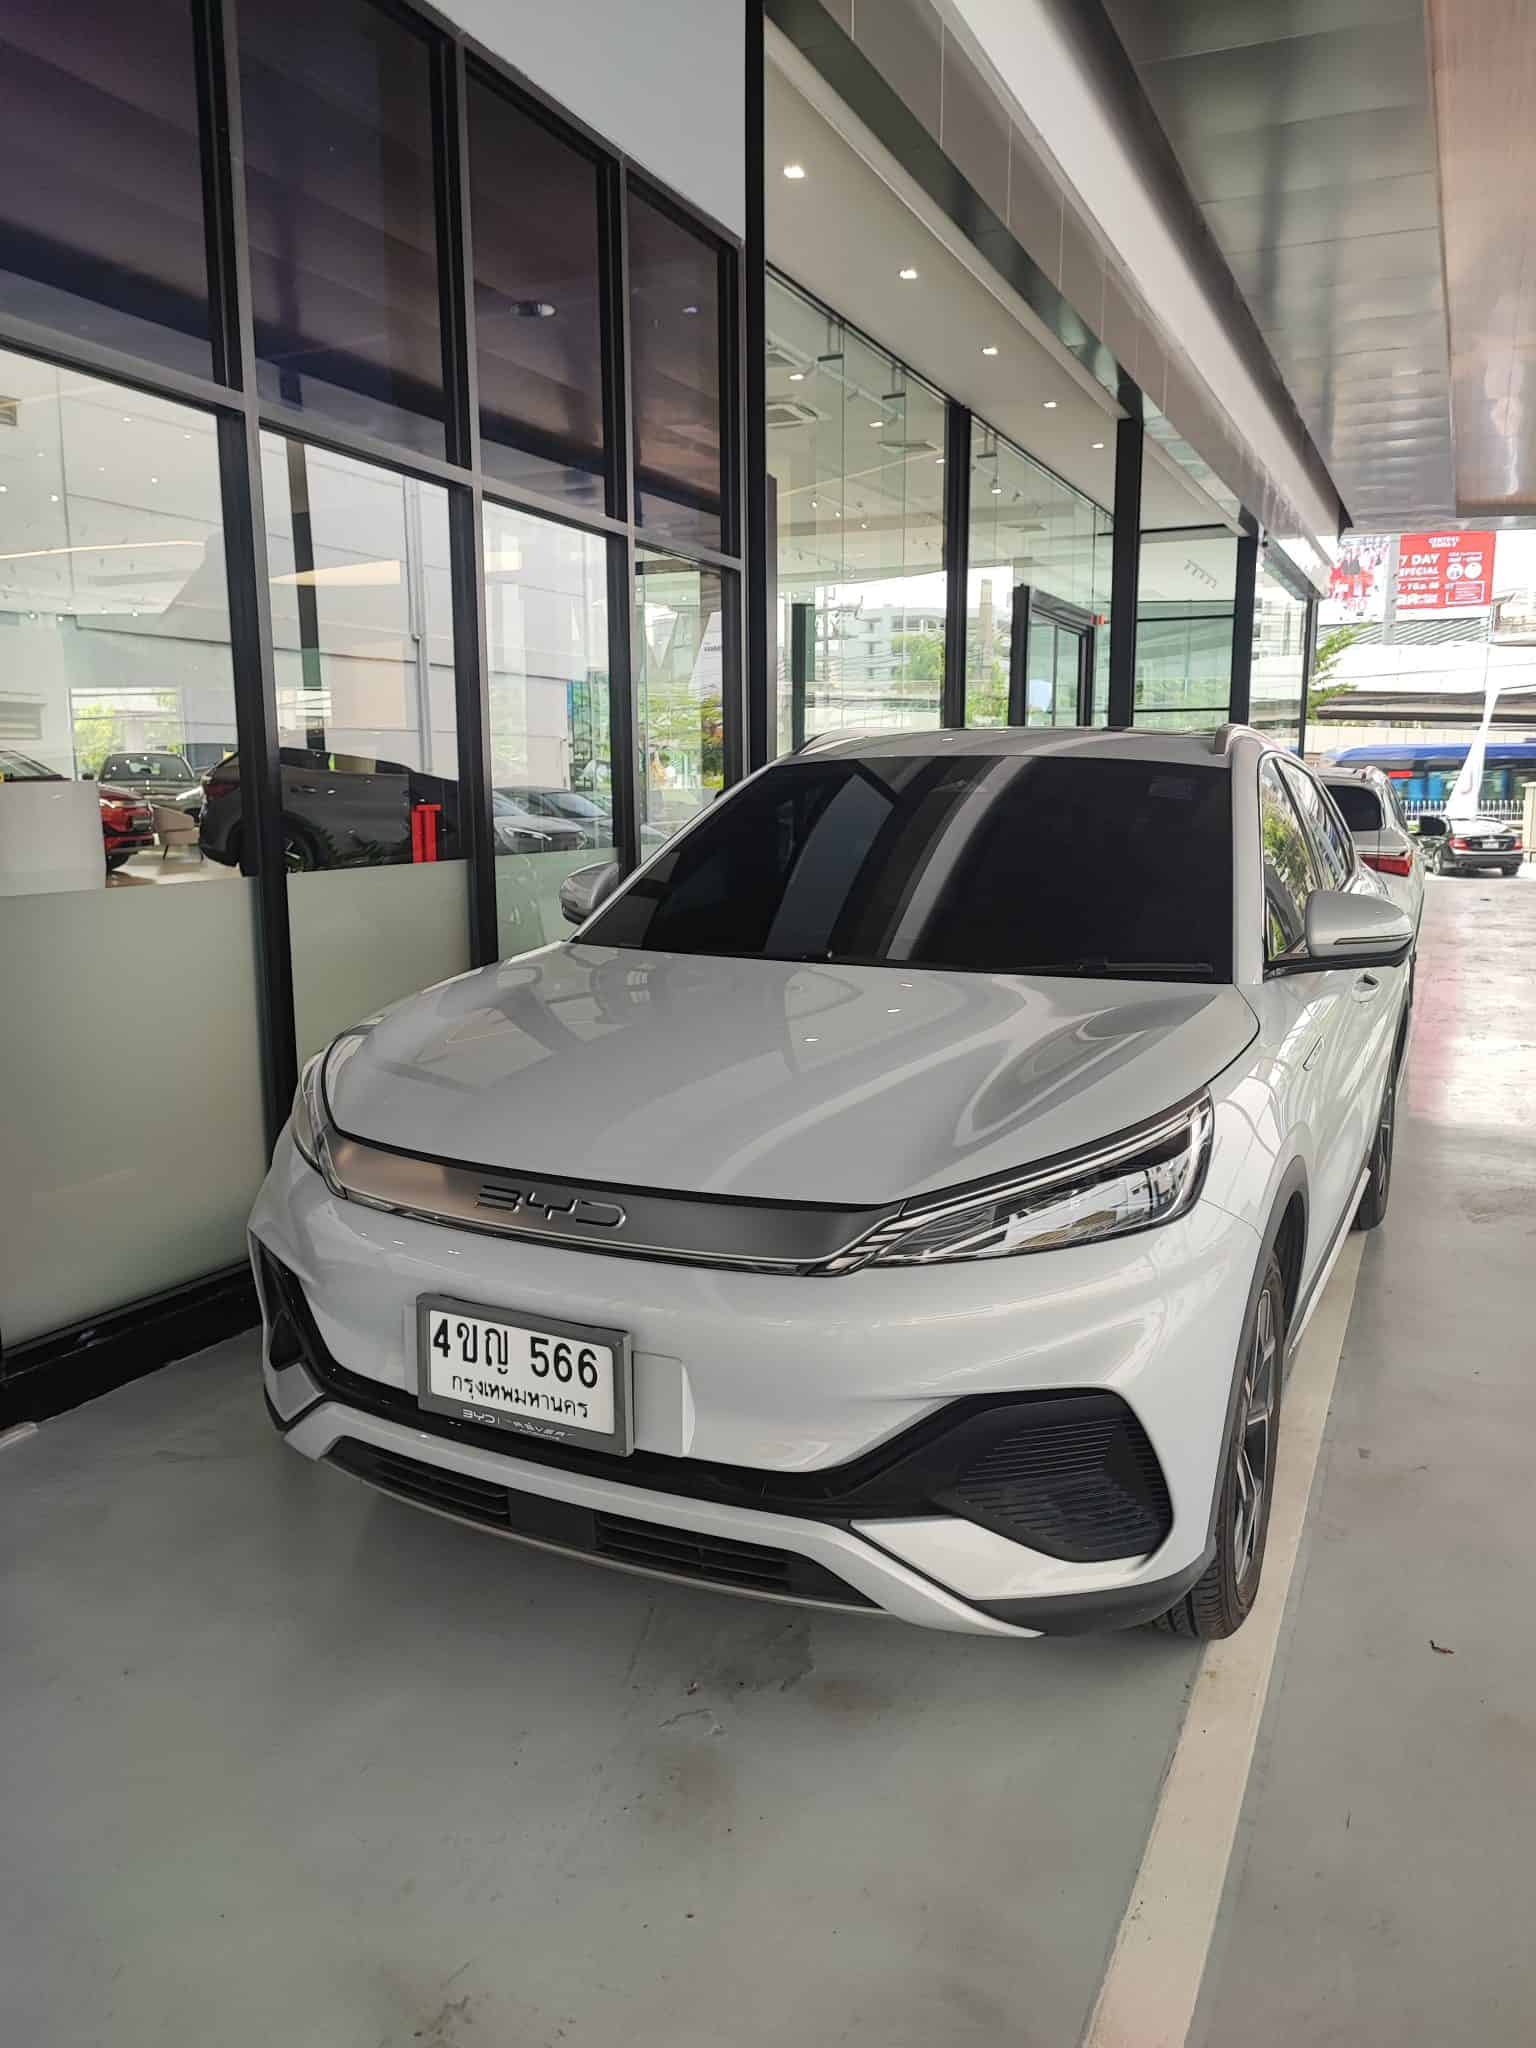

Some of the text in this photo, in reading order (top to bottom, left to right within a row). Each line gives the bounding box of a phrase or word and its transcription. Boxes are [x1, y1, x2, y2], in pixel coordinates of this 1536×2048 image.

[1412, 553, 1440, 566] DAY
[473, 1184, 627, 1229] BYD
[433, 1318, 598, 1388] 4ขญ 566
[452, 1375, 590, 1418] กรุงเทพมหานคร
[463, 1408, 495, 1424] BYD
